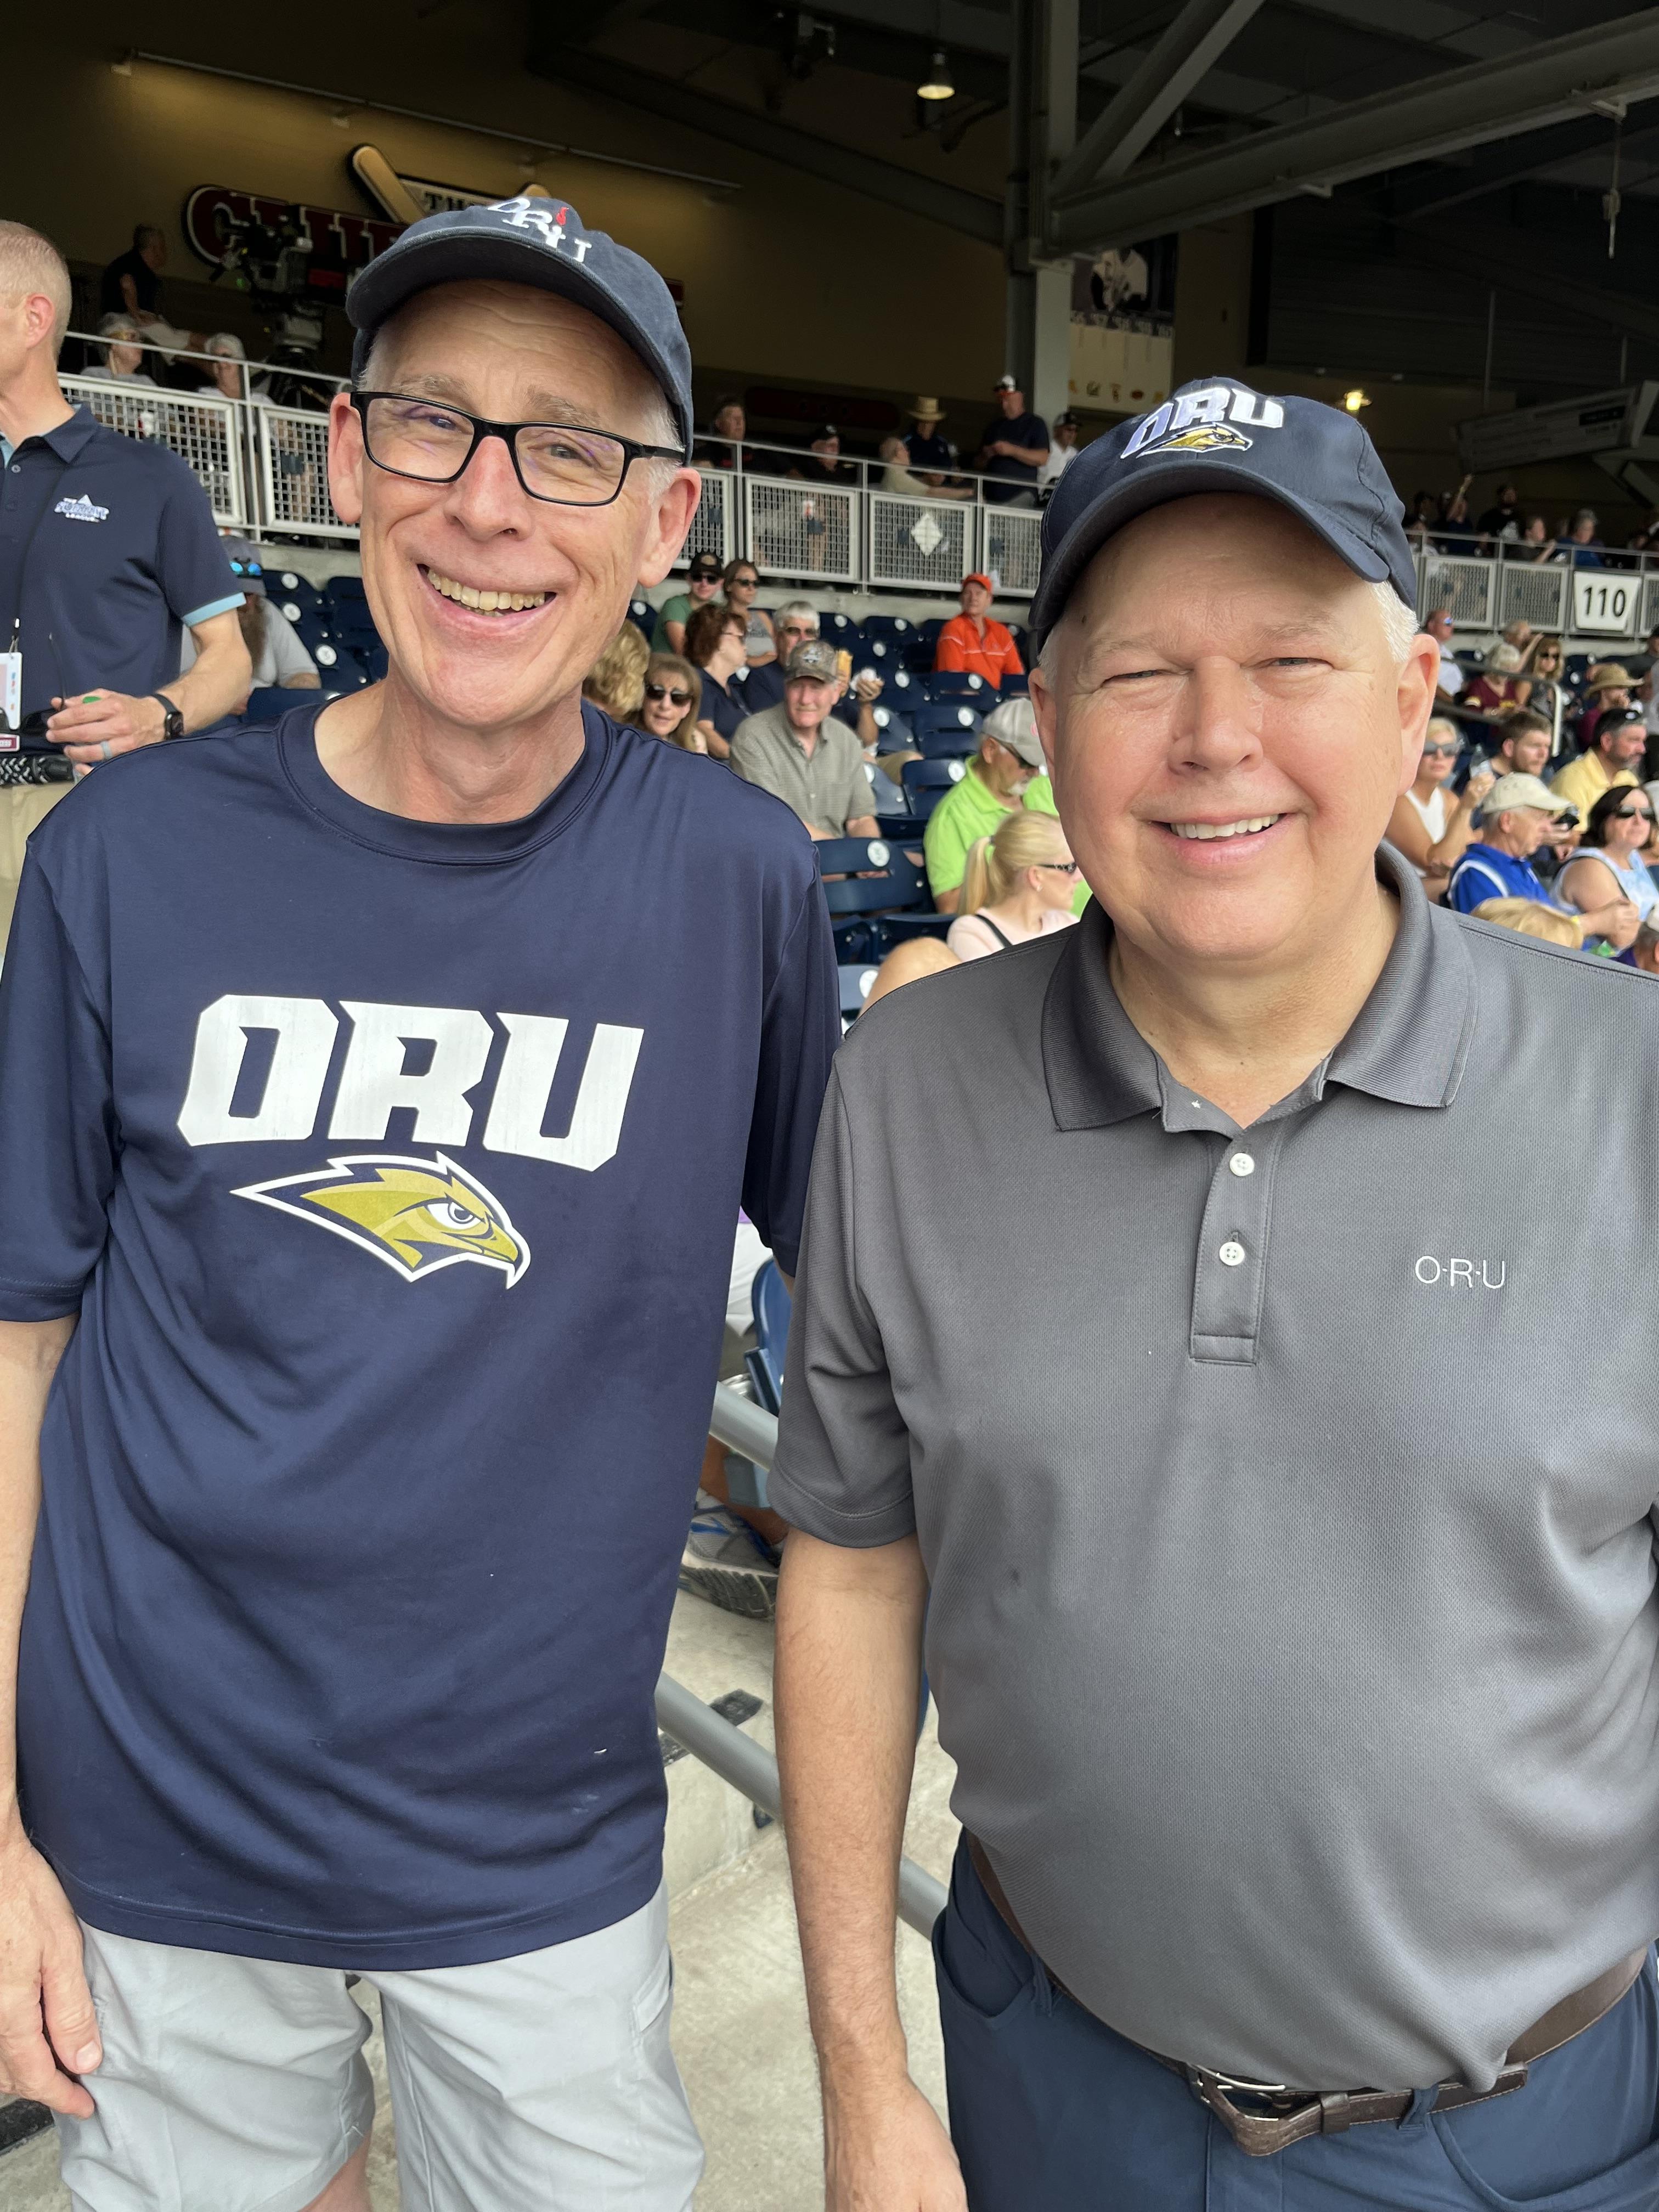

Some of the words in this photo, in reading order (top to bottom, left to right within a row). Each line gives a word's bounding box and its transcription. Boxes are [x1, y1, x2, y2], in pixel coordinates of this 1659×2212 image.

[1120, 387, 1284, 460] ORU
[1584, 587, 1626, 617] 110
[177, 994, 644, 1172] ORU
